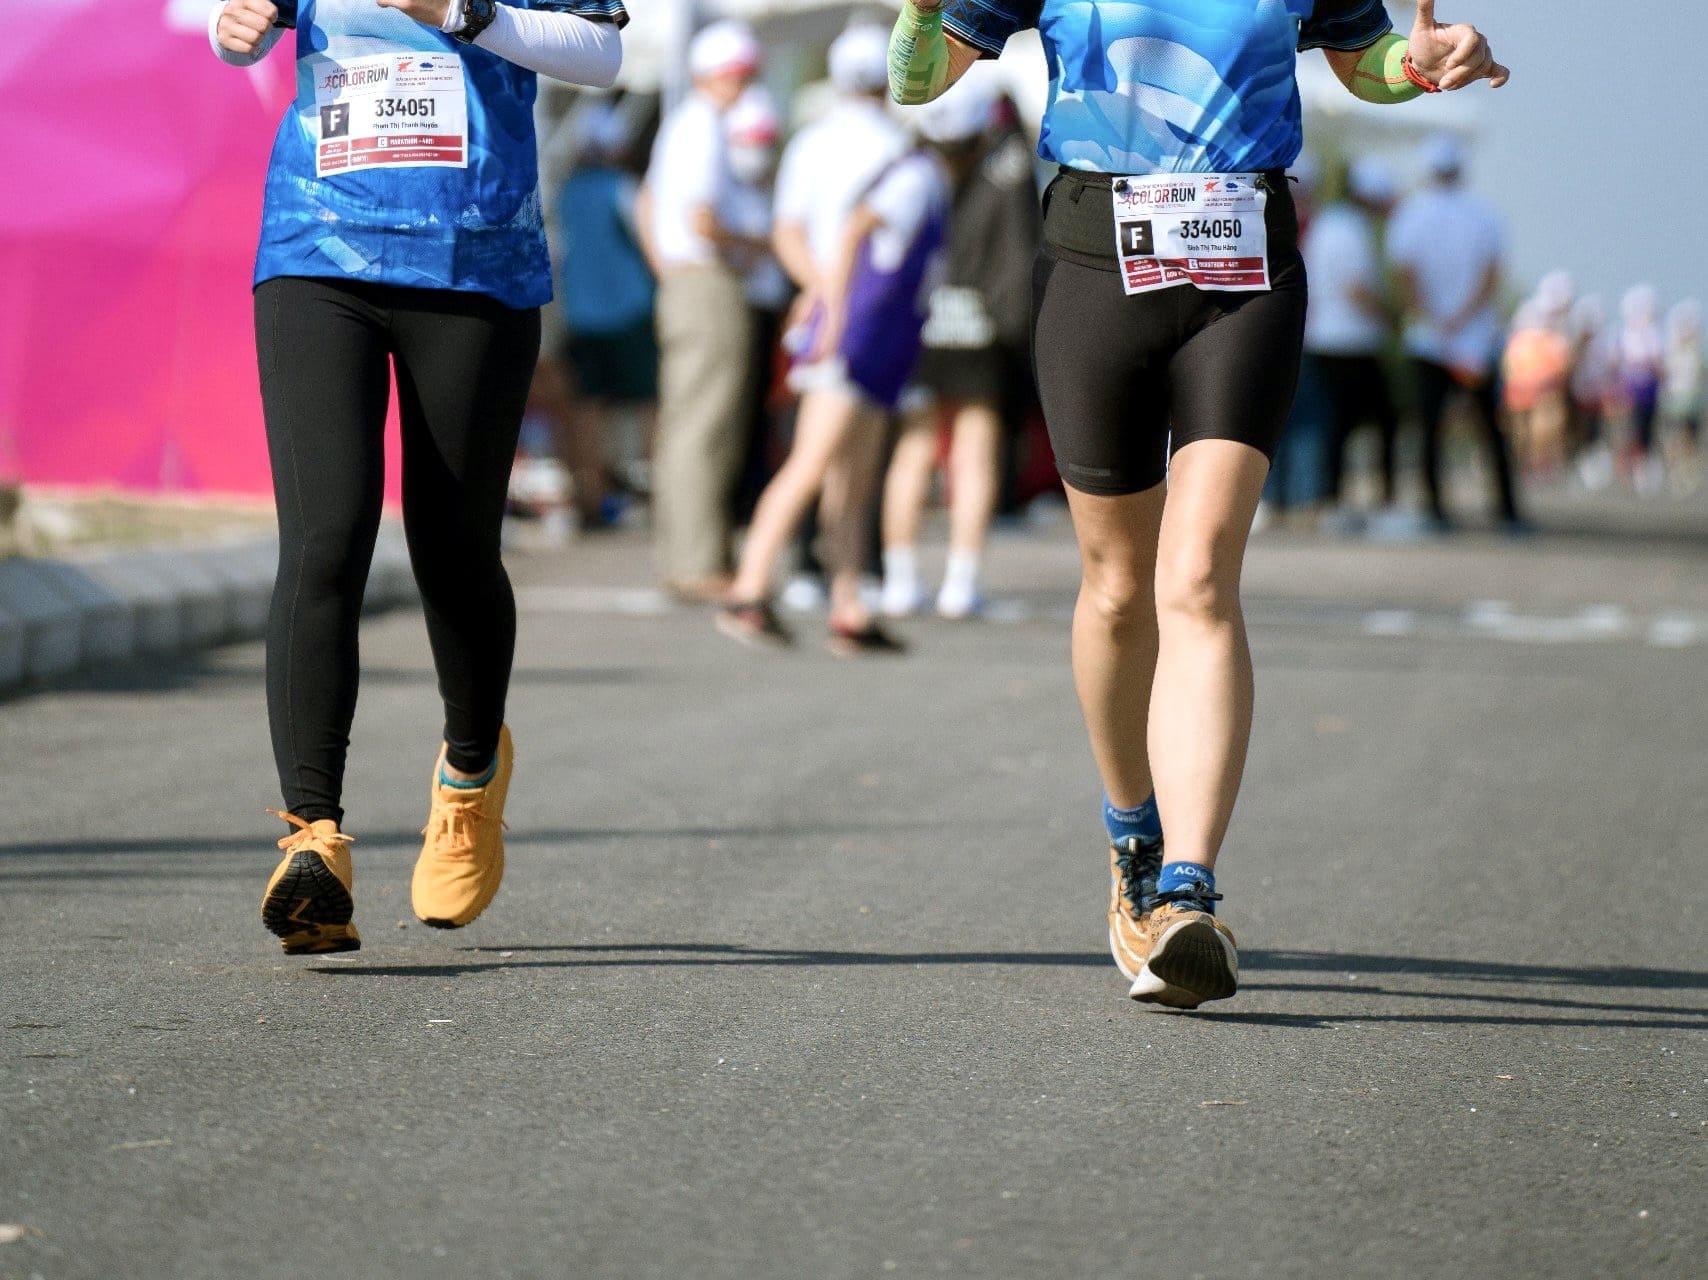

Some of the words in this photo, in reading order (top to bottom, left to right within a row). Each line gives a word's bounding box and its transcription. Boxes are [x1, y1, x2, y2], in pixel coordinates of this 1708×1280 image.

[375, 98, 436, 117] 334051
[331, 109, 342, 132] F
[1130, 226, 1143, 250] F
[1180, 220, 1242, 239] 334050
